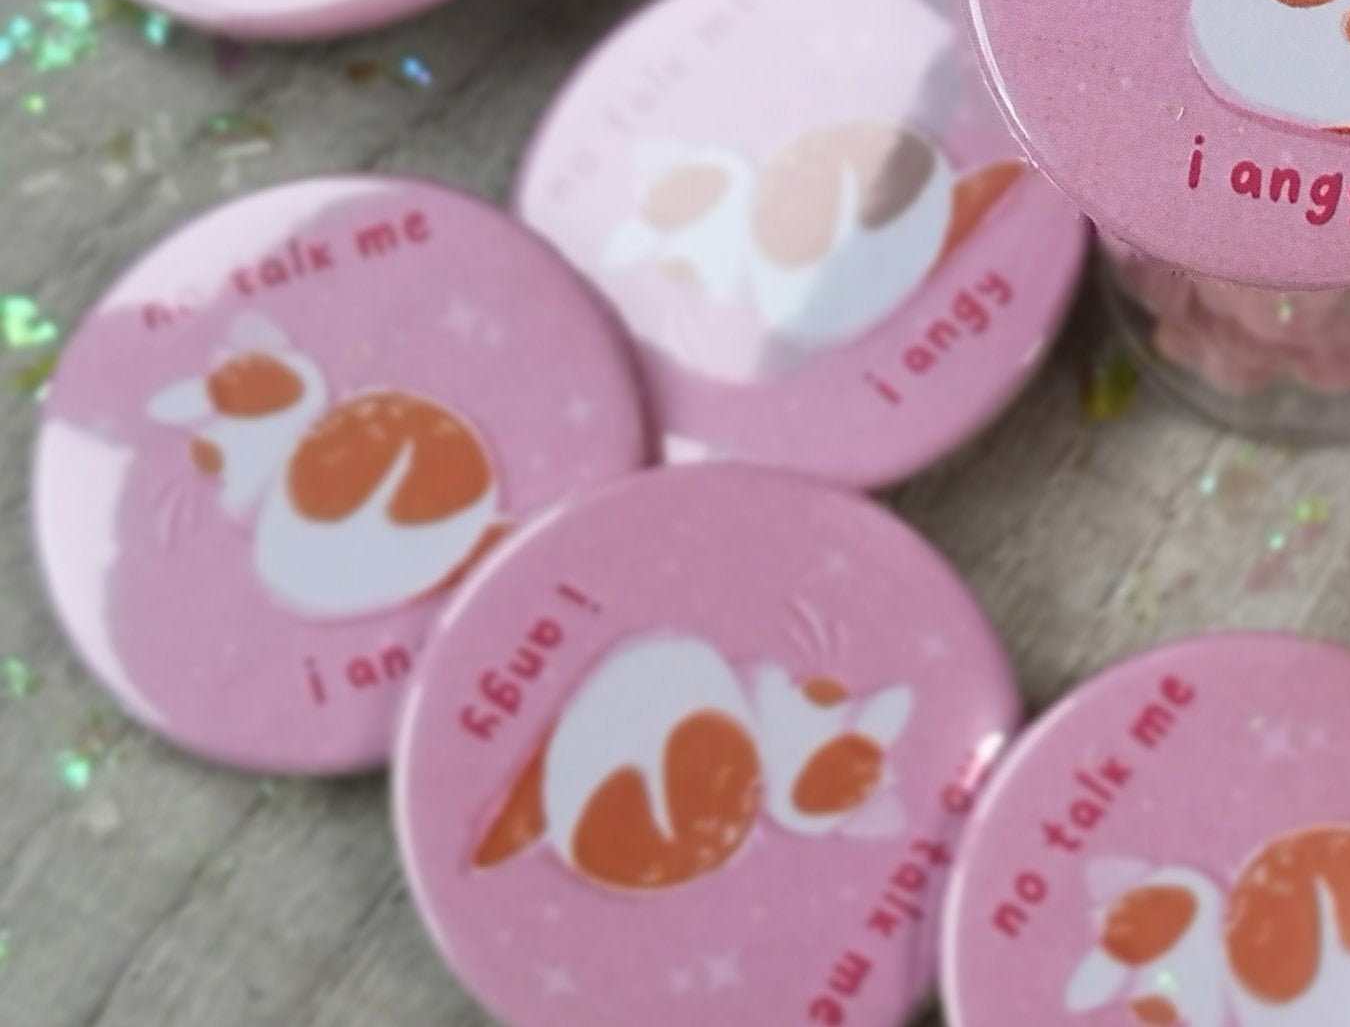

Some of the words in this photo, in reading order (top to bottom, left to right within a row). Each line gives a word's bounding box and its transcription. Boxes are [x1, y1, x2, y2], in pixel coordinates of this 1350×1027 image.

[1187, 134, 1205, 188] i
[354, 211, 430, 258] me
[903, 271, 1012, 374] angy
[460, 619, 564, 740] angy
[991, 871, 1046, 938] no
[1043, 758, 1132, 853] talk
[1130, 674, 1194, 750] me
[866, 838, 951, 937] talk
[809, 952, 871, 1027] me
